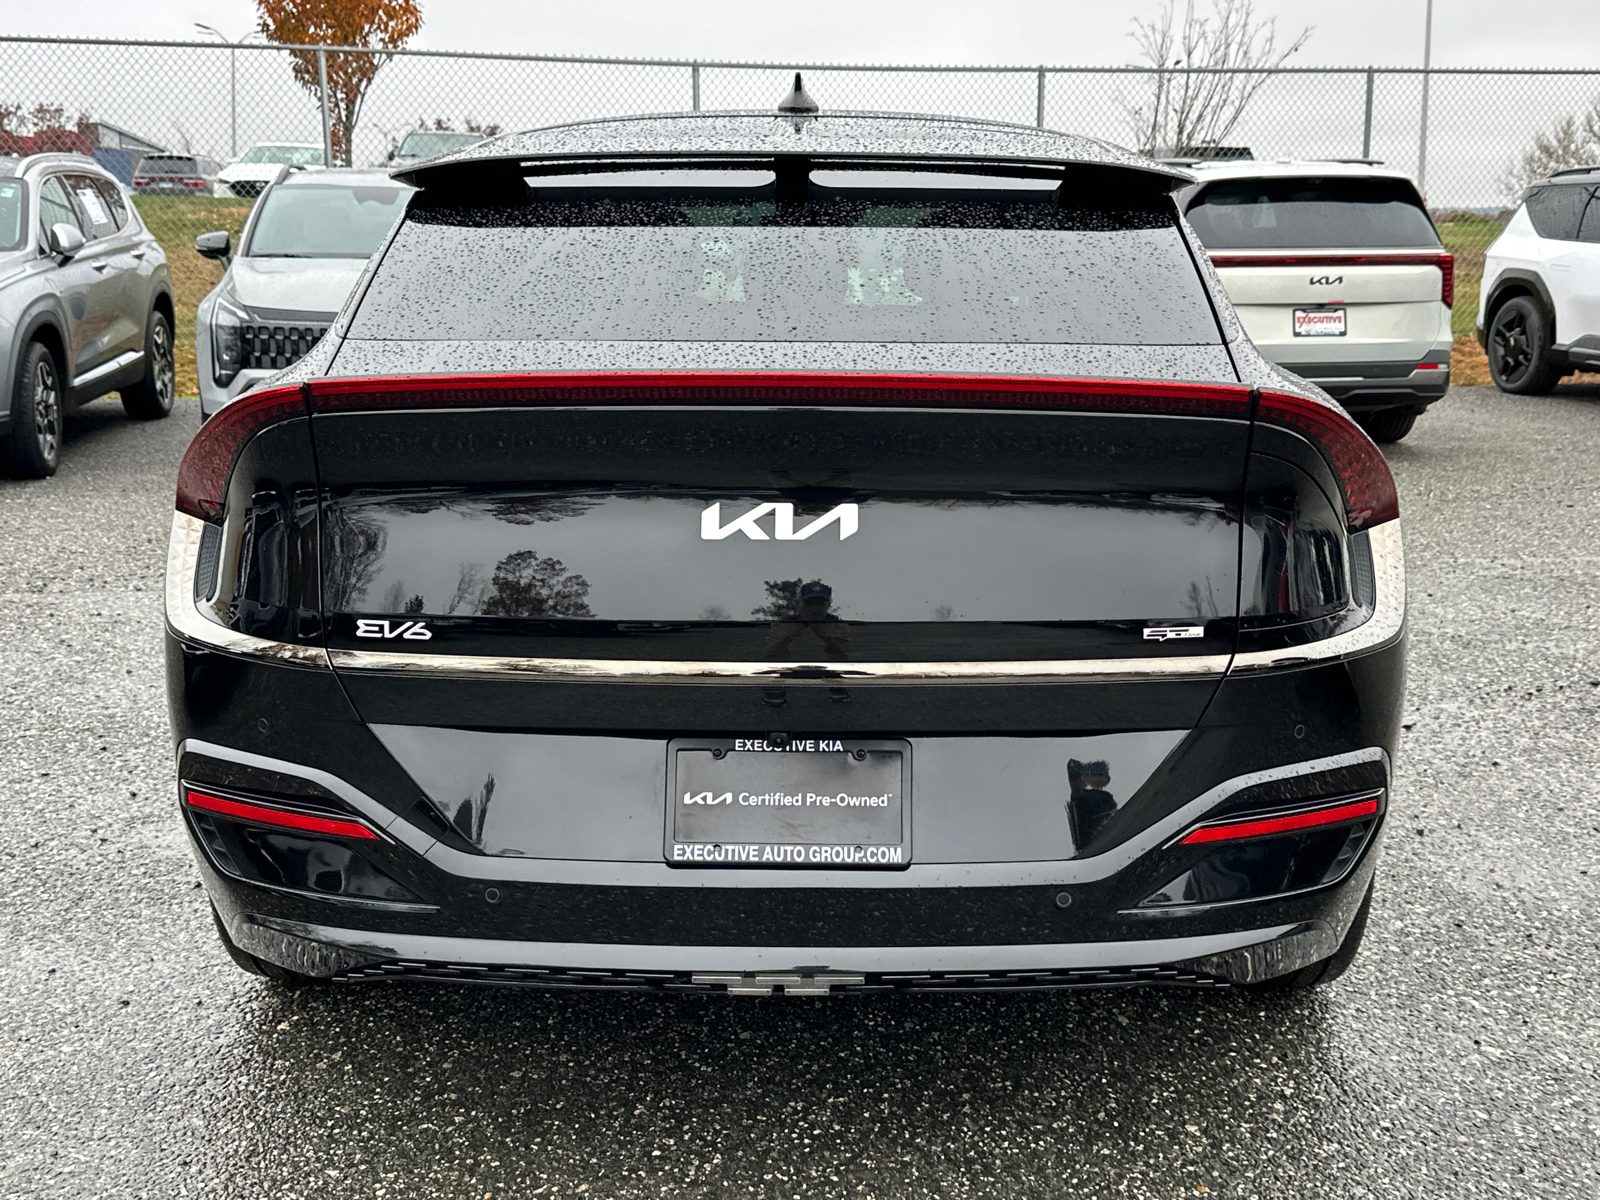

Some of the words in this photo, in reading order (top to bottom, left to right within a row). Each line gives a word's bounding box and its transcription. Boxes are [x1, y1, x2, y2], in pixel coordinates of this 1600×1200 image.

[1309, 276, 1343, 285] KIA
[701, 502, 858, 540] KIA
[356, 619, 432, 640] EV6
[820, 740, 844, 751] KIA
[683, 791, 732, 804] KIA
[738, 793, 801, 806] Certified
[673, 844, 759, 861] EXECUTIVE
[762, 845, 805, 862] AUTO
[809, 845, 902, 863] GROUP.COM
